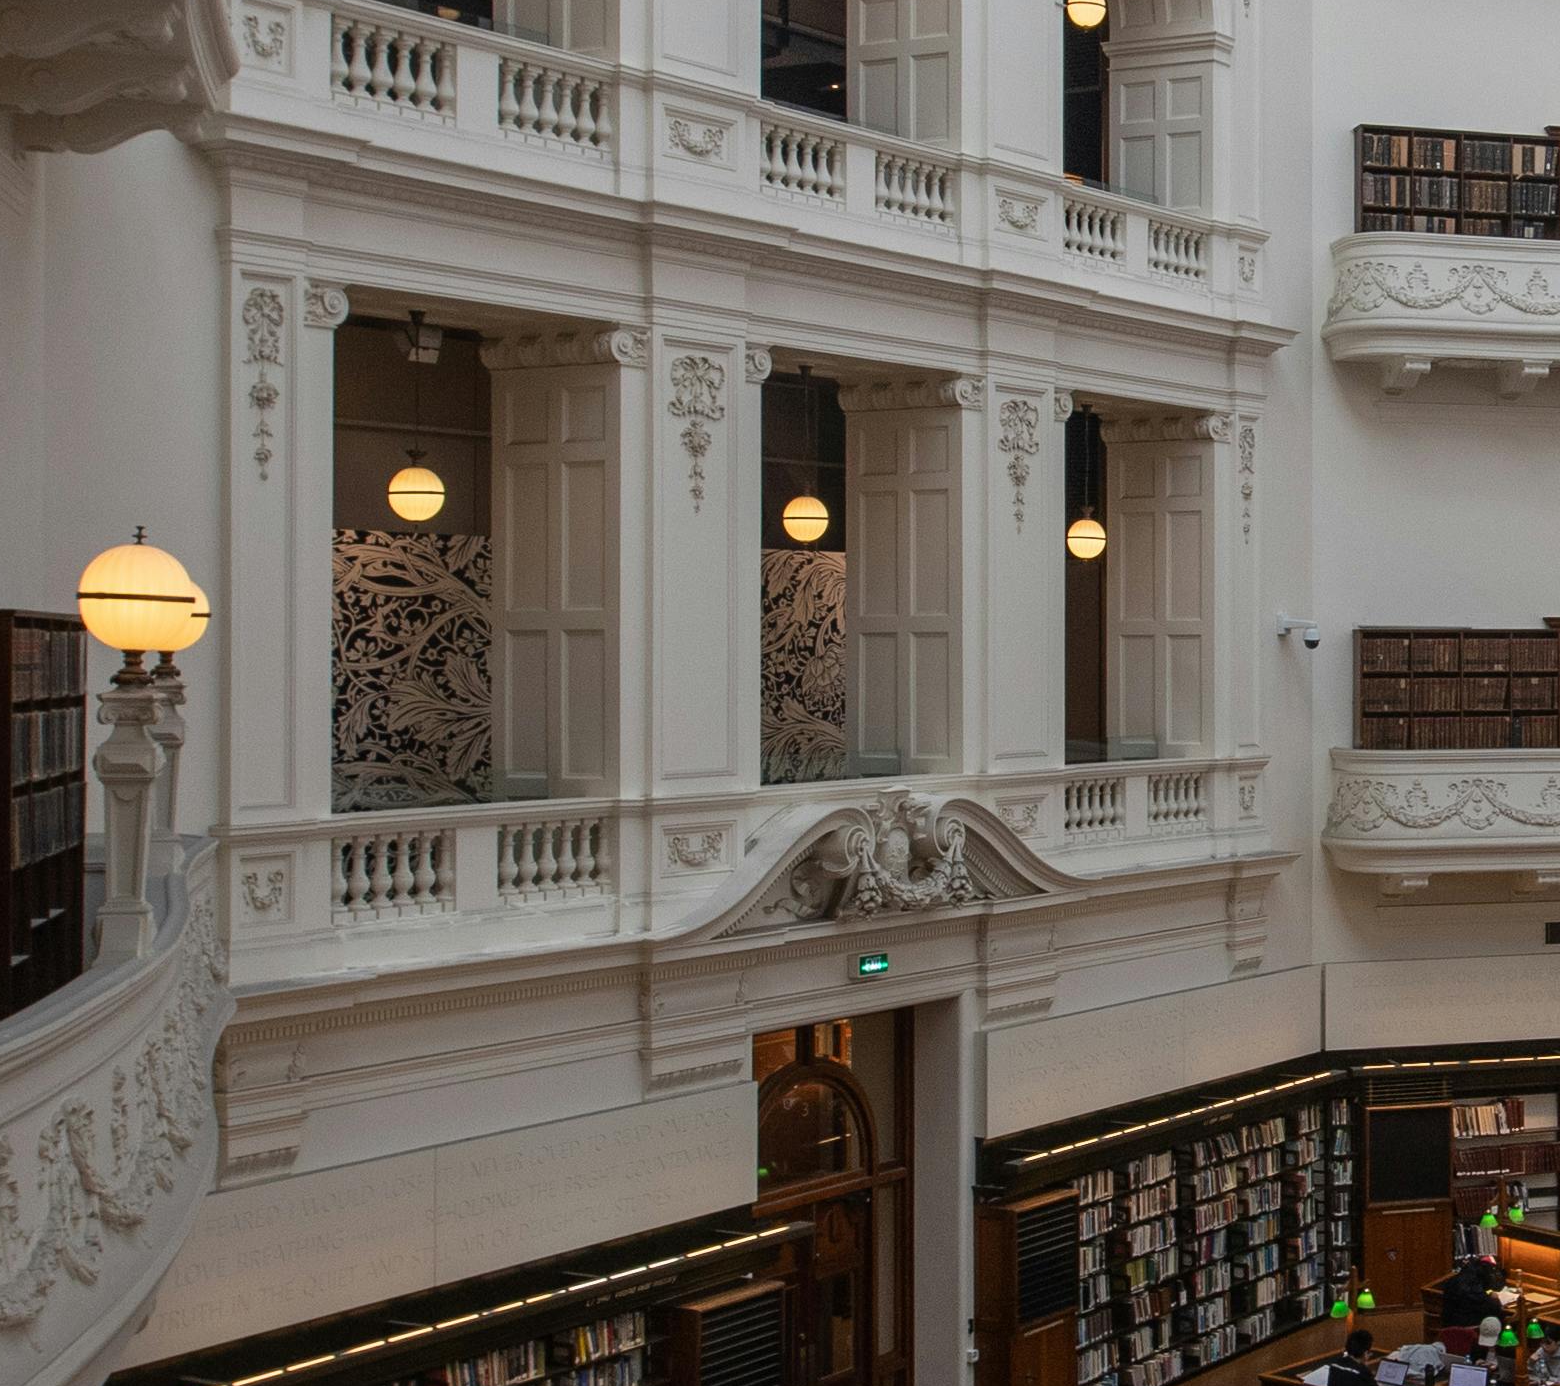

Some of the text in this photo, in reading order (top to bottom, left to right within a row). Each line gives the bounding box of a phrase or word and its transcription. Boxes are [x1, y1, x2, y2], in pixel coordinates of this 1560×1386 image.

[529, 1178, 556, 1203] THE
[205, 1203, 280, 1241] FEARED
[174, 1256, 226, 1289] LOVE
[258, 1279, 294, 1309] THE
[302, 1263, 358, 1300] QUIET
[365, 1252, 404, 1281] AND
[459, 1232, 484, 1257] AIR
